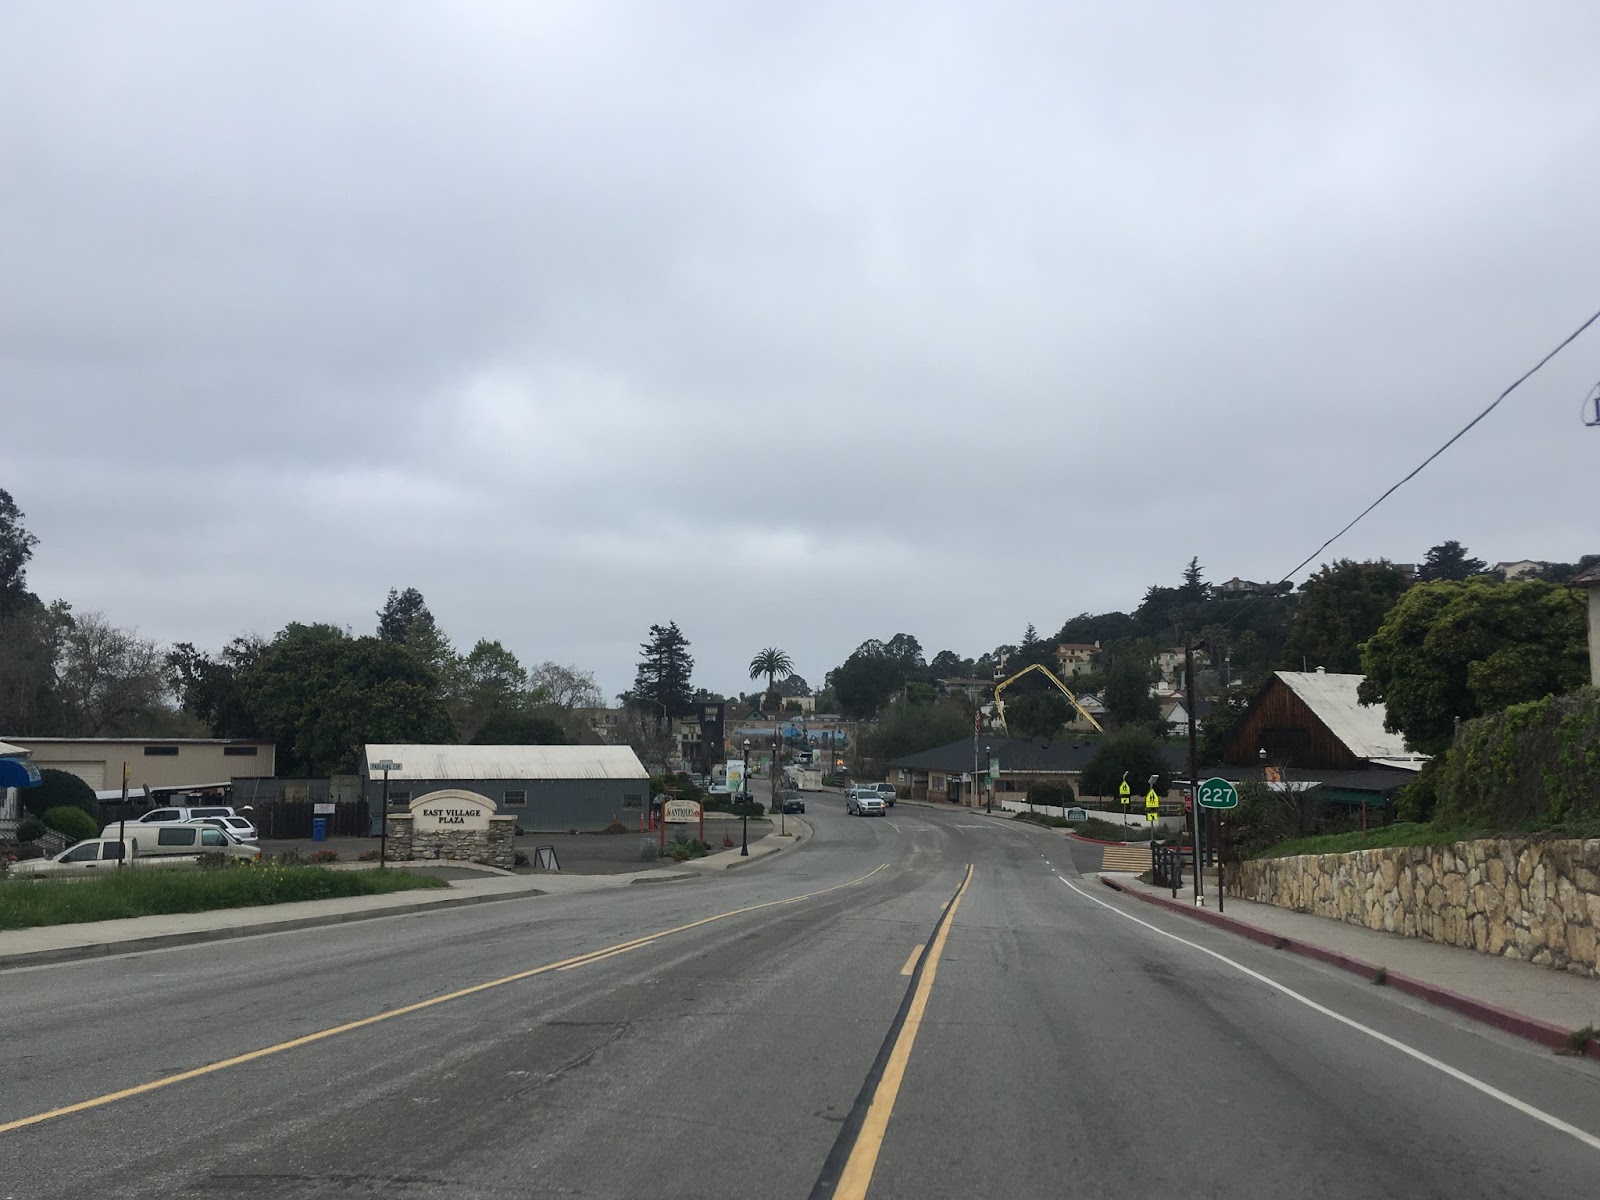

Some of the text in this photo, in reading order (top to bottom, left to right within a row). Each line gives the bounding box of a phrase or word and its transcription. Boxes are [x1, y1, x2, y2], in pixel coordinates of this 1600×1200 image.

[1202, 787, 1233, 803] 227
[423, 809, 481, 817] EAST VILLAGE
[671, 808, 695, 817] ANTIQUES
[438, 816, 465, 824] PLAZA
